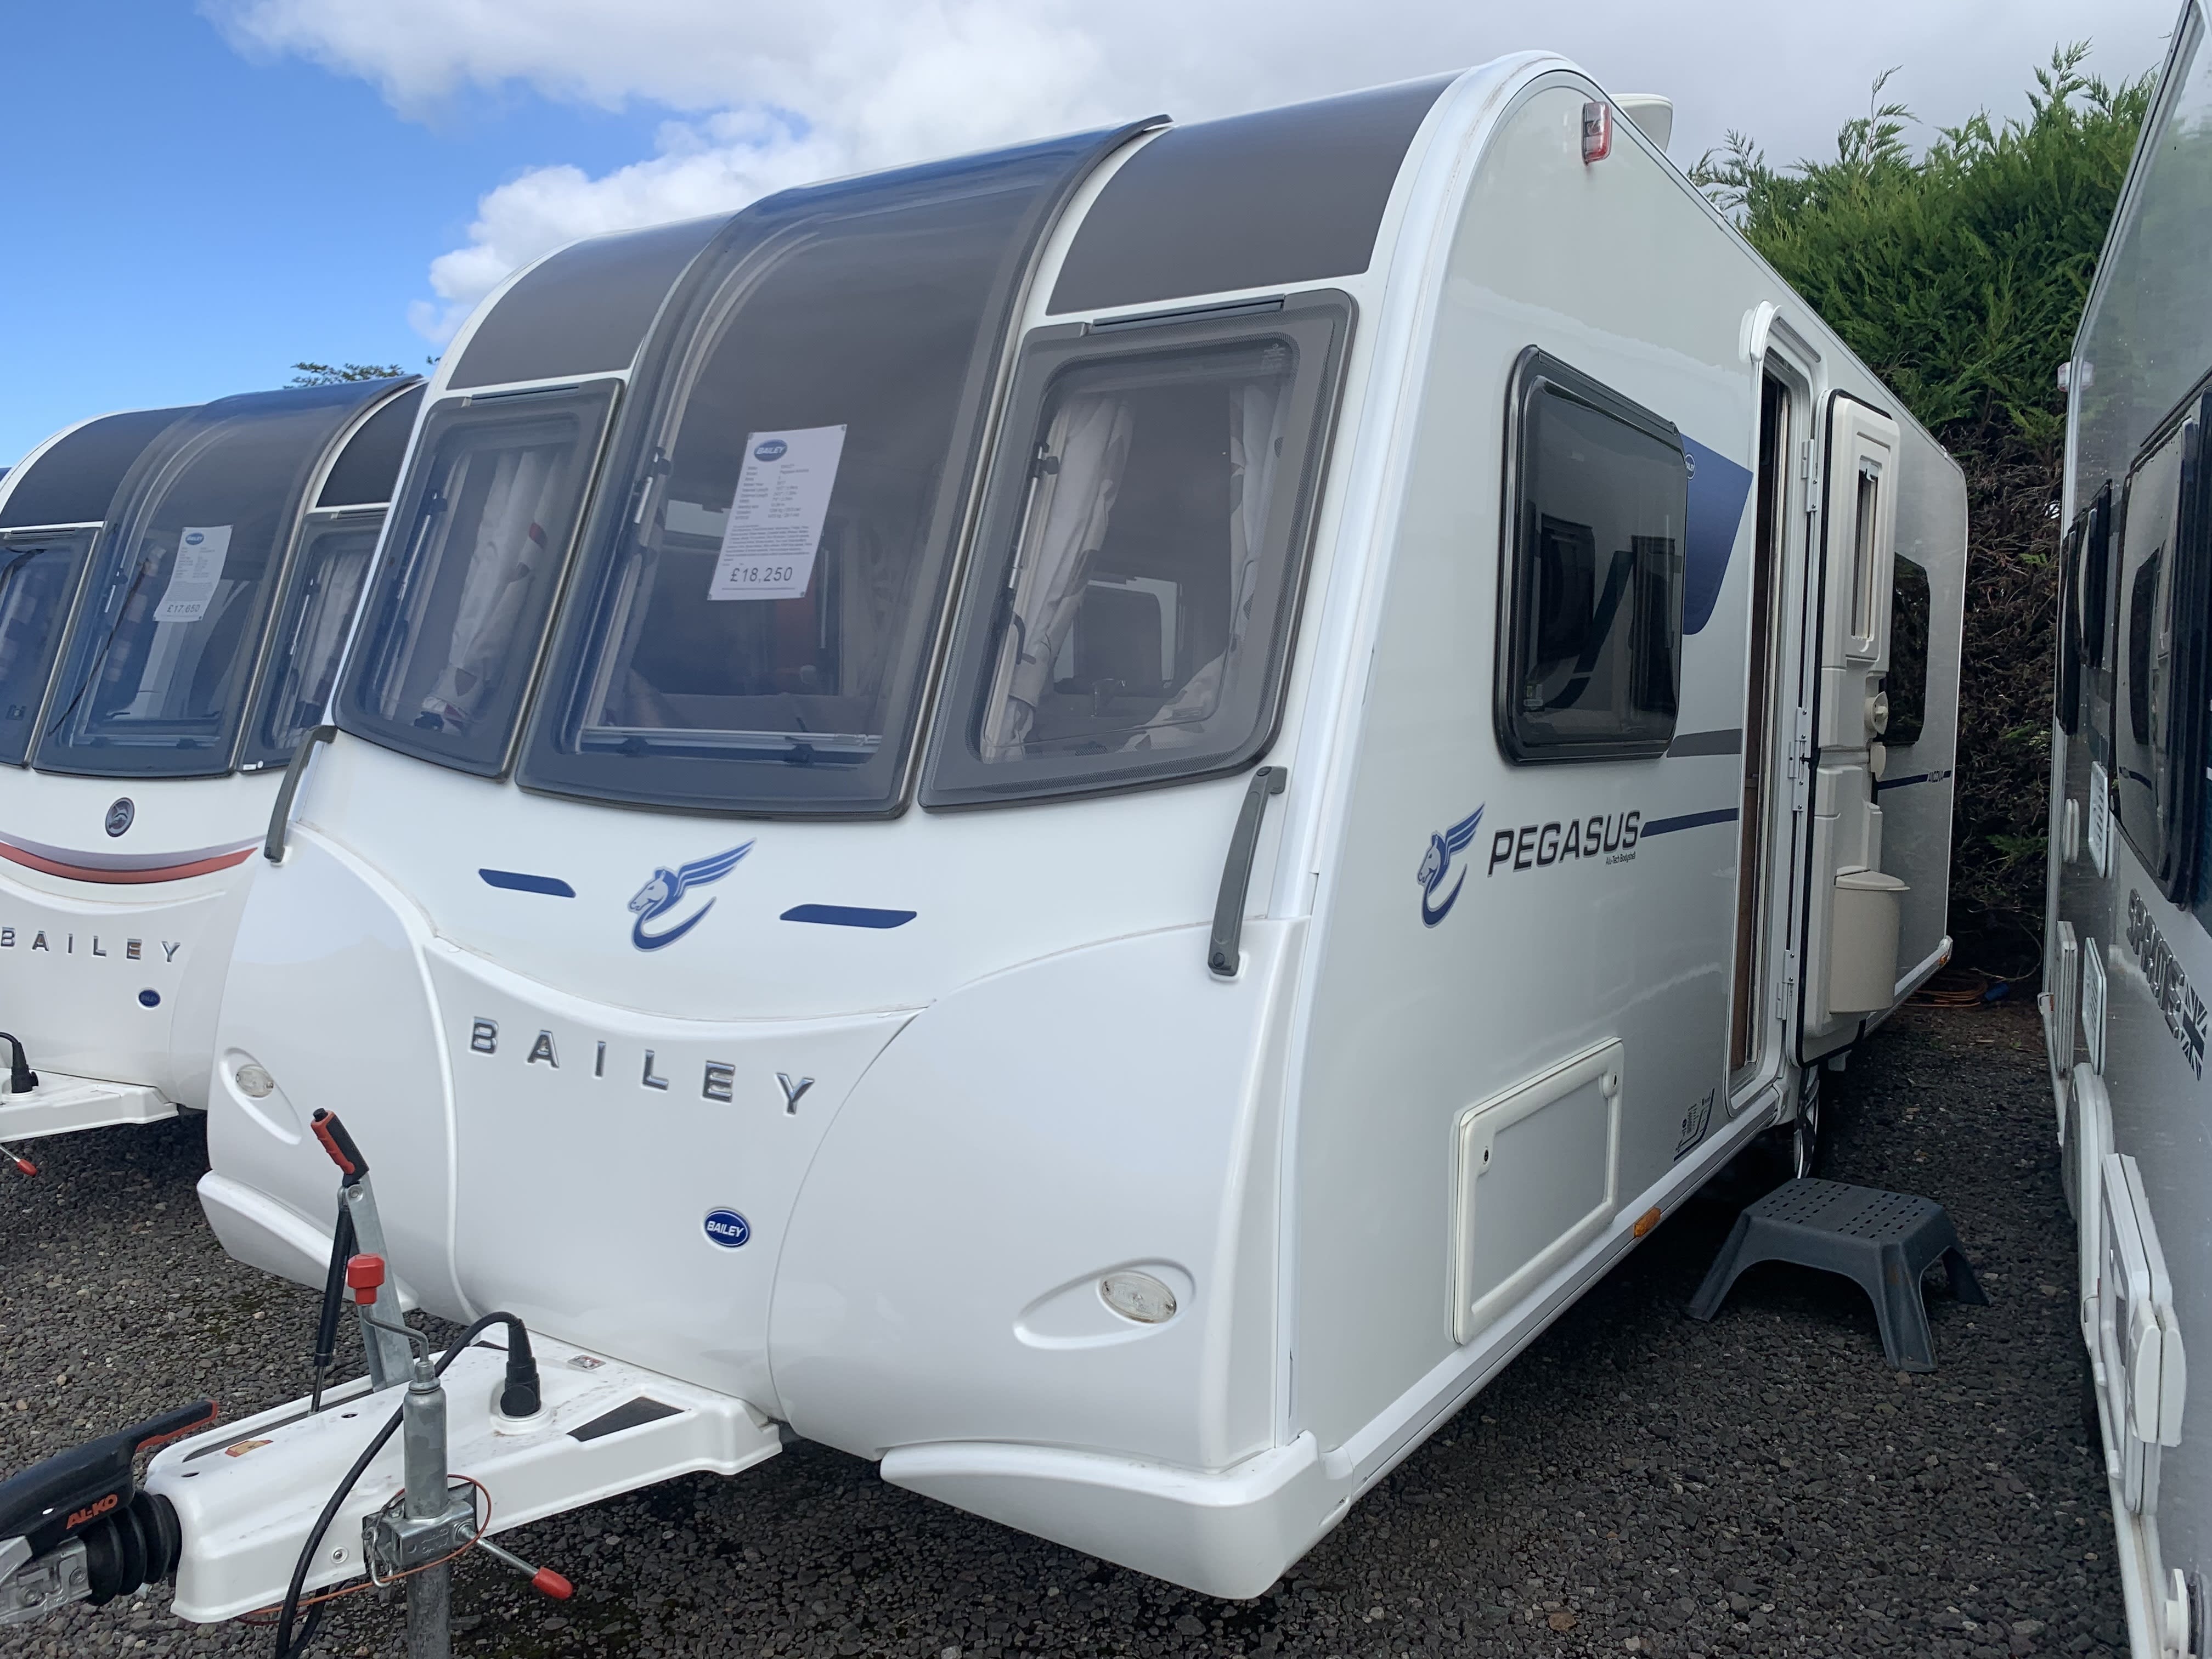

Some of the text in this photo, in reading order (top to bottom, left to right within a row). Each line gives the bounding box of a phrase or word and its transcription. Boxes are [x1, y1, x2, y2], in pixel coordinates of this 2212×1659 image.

[757, 447, 785, 455] BAILEY
[730, 567, 793, 583] £18,250
[1487, 810, 1640, 877] PEGASUS
[1, 927, 180, 963] BAILEY
[470, 1016, 815, 1115] BAILEY
[706, 1220, 744, 1239] BAILEY
[66, 1493, 118, 1530] AL-KO
